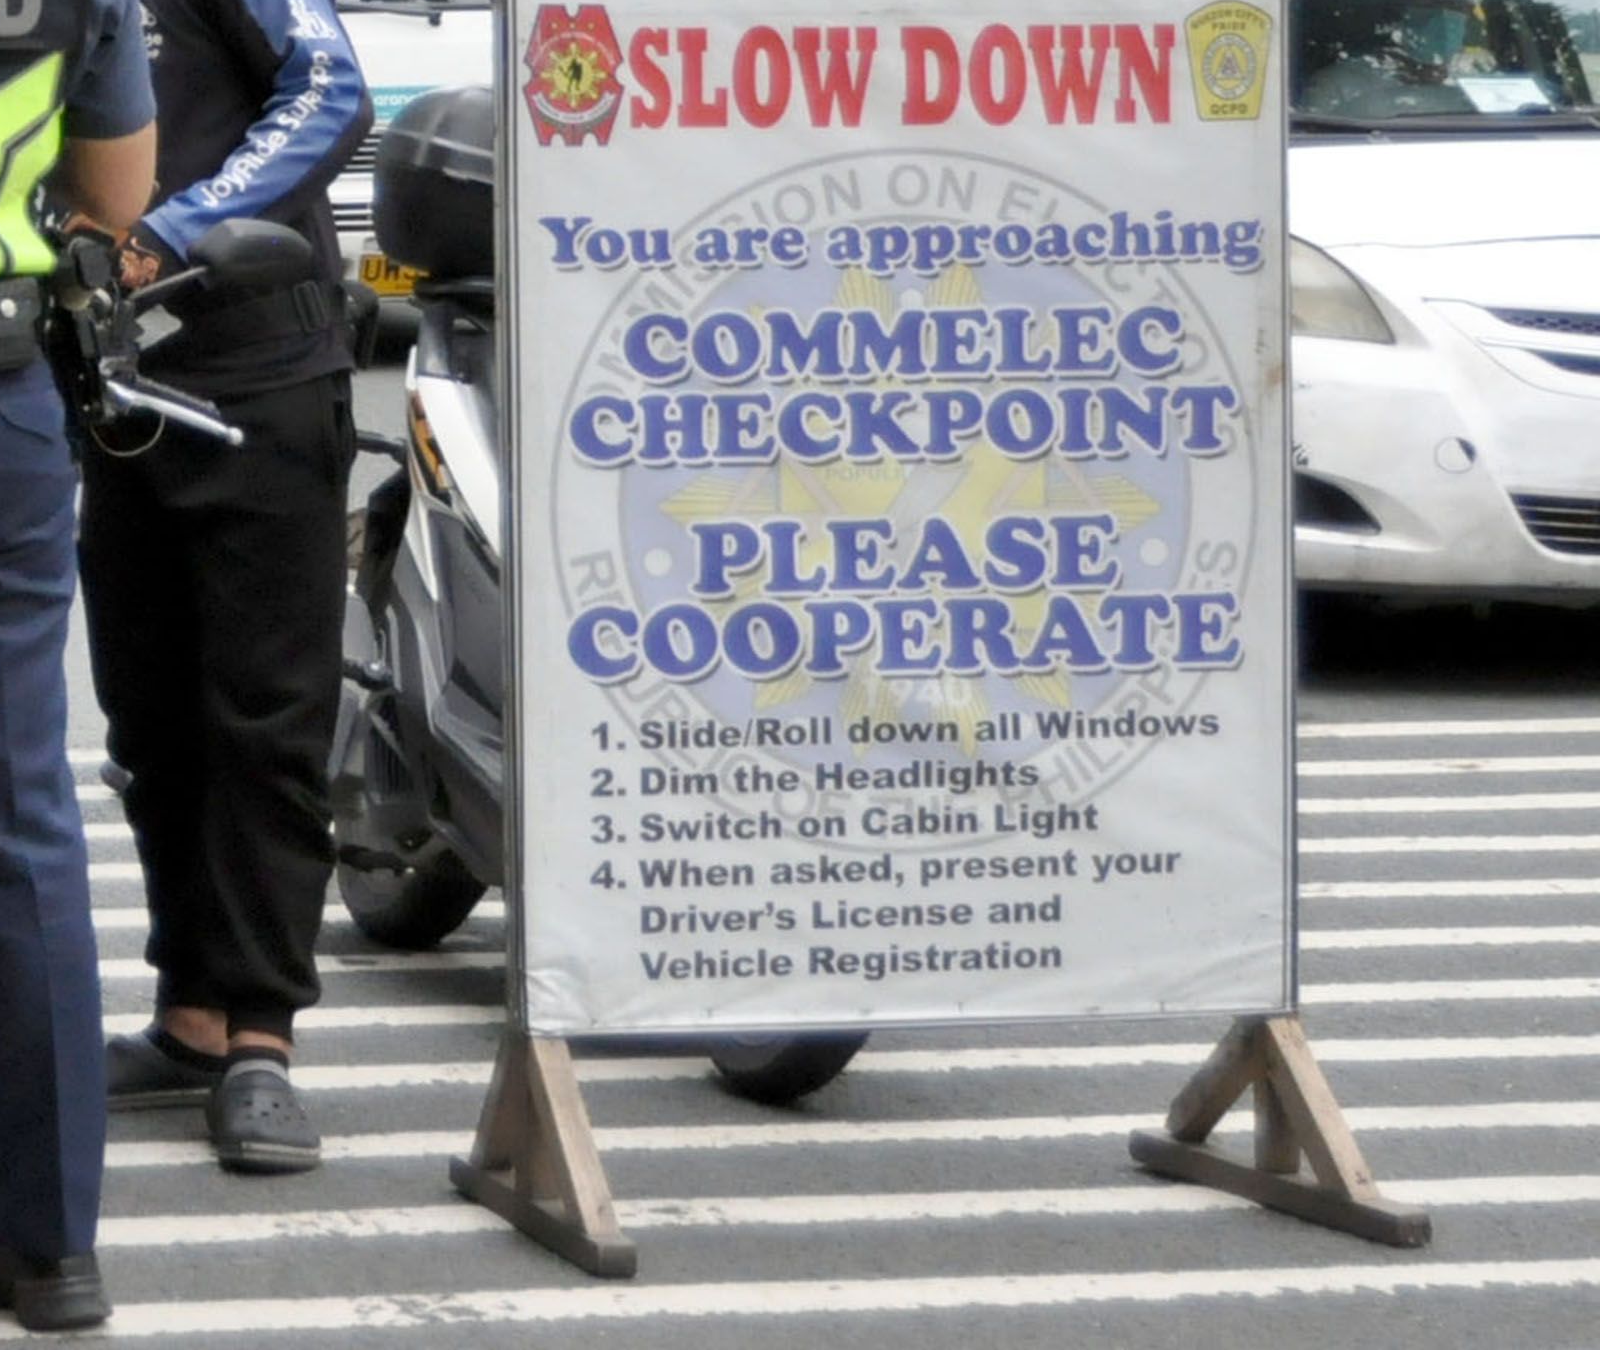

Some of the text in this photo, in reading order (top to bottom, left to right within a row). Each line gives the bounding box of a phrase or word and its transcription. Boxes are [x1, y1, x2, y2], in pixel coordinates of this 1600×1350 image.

[630, 23, 1176, 129] SLOW DOWN
[1210, 102, 1248, 116] QCPD
[886, 162, 978, 214] ON
[539, 210, 1261, 272] You are approaching
[623, 306, 1183, 380] COMMELEC
[569, 385, 1238, 462] CHECKPOINT
[691, 514, 1119, 595] PLEASE
[567, 591, 1241, 679] COOPERATE
[592, 709, 1220, 750] 1. Slide/Roll down all Windows
[592, 759, 1040, 797] 2. Dim the Headlights
[592, 804, 1098, 843] 3. Switch on Cabin Light
[591, 851, 1180, 889] 4. When asked, present your
[641, 895, 1061, 933] Driver's License and
[641, 943, 1062, 981] Vehicle Registration
